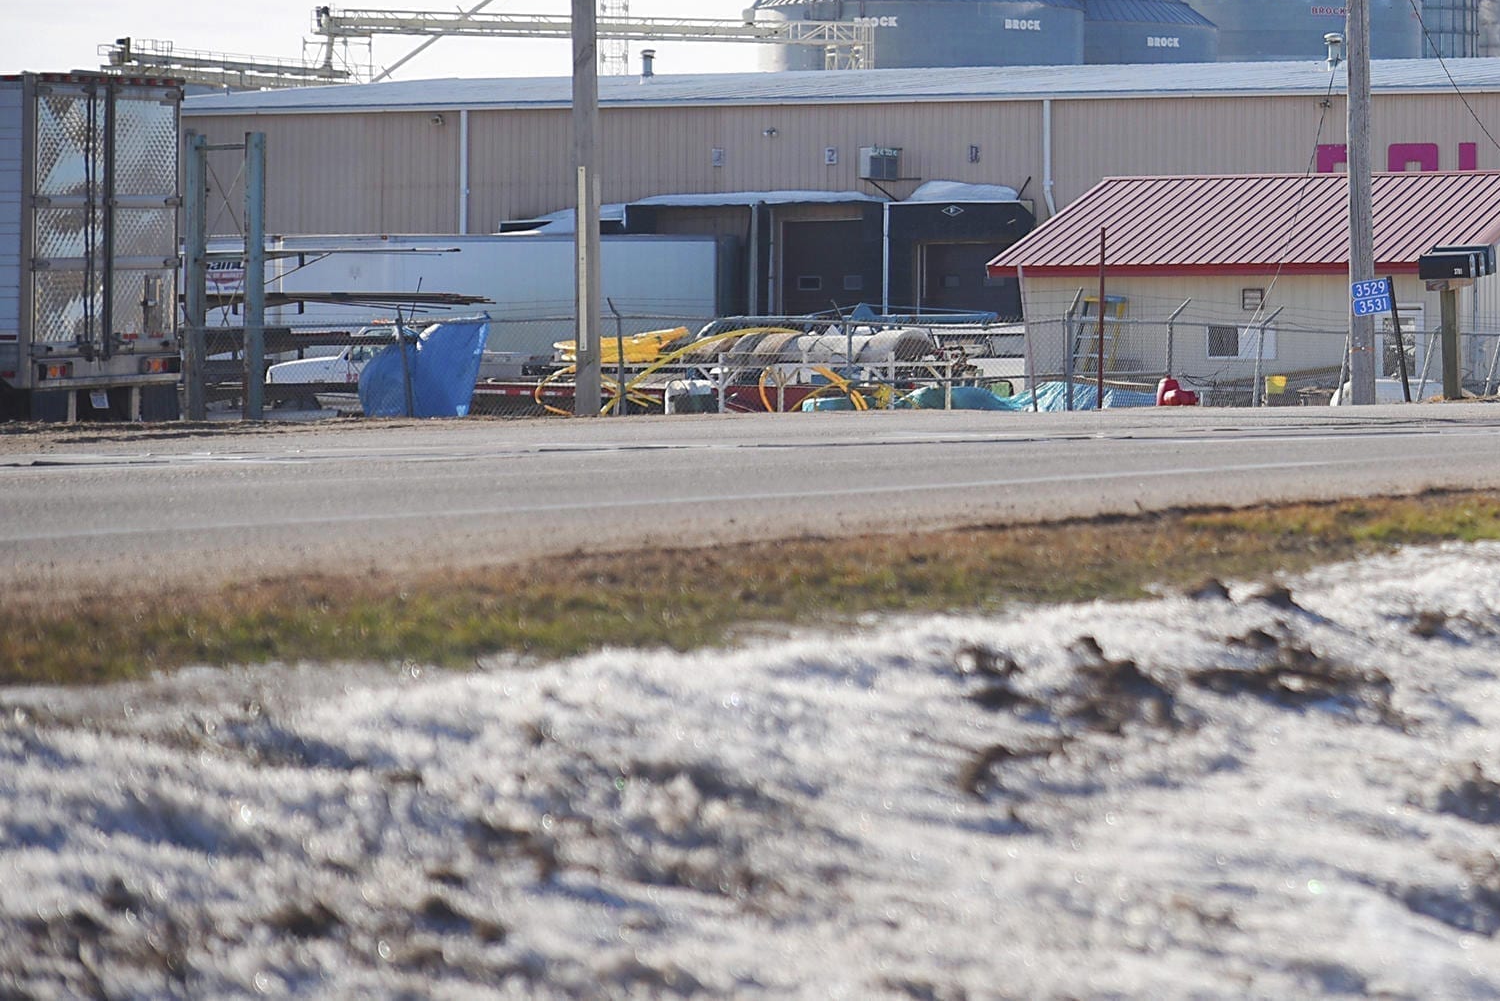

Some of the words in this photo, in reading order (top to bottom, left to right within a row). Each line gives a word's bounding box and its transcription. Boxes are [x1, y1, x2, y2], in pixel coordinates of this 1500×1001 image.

[1004, 18, 1041, 31] BROCK
[1146, 36, 1180, 48] BROCK
[1355, 280, 1386, 297] 3529
[1359, 297, 1388, 313] 3531
